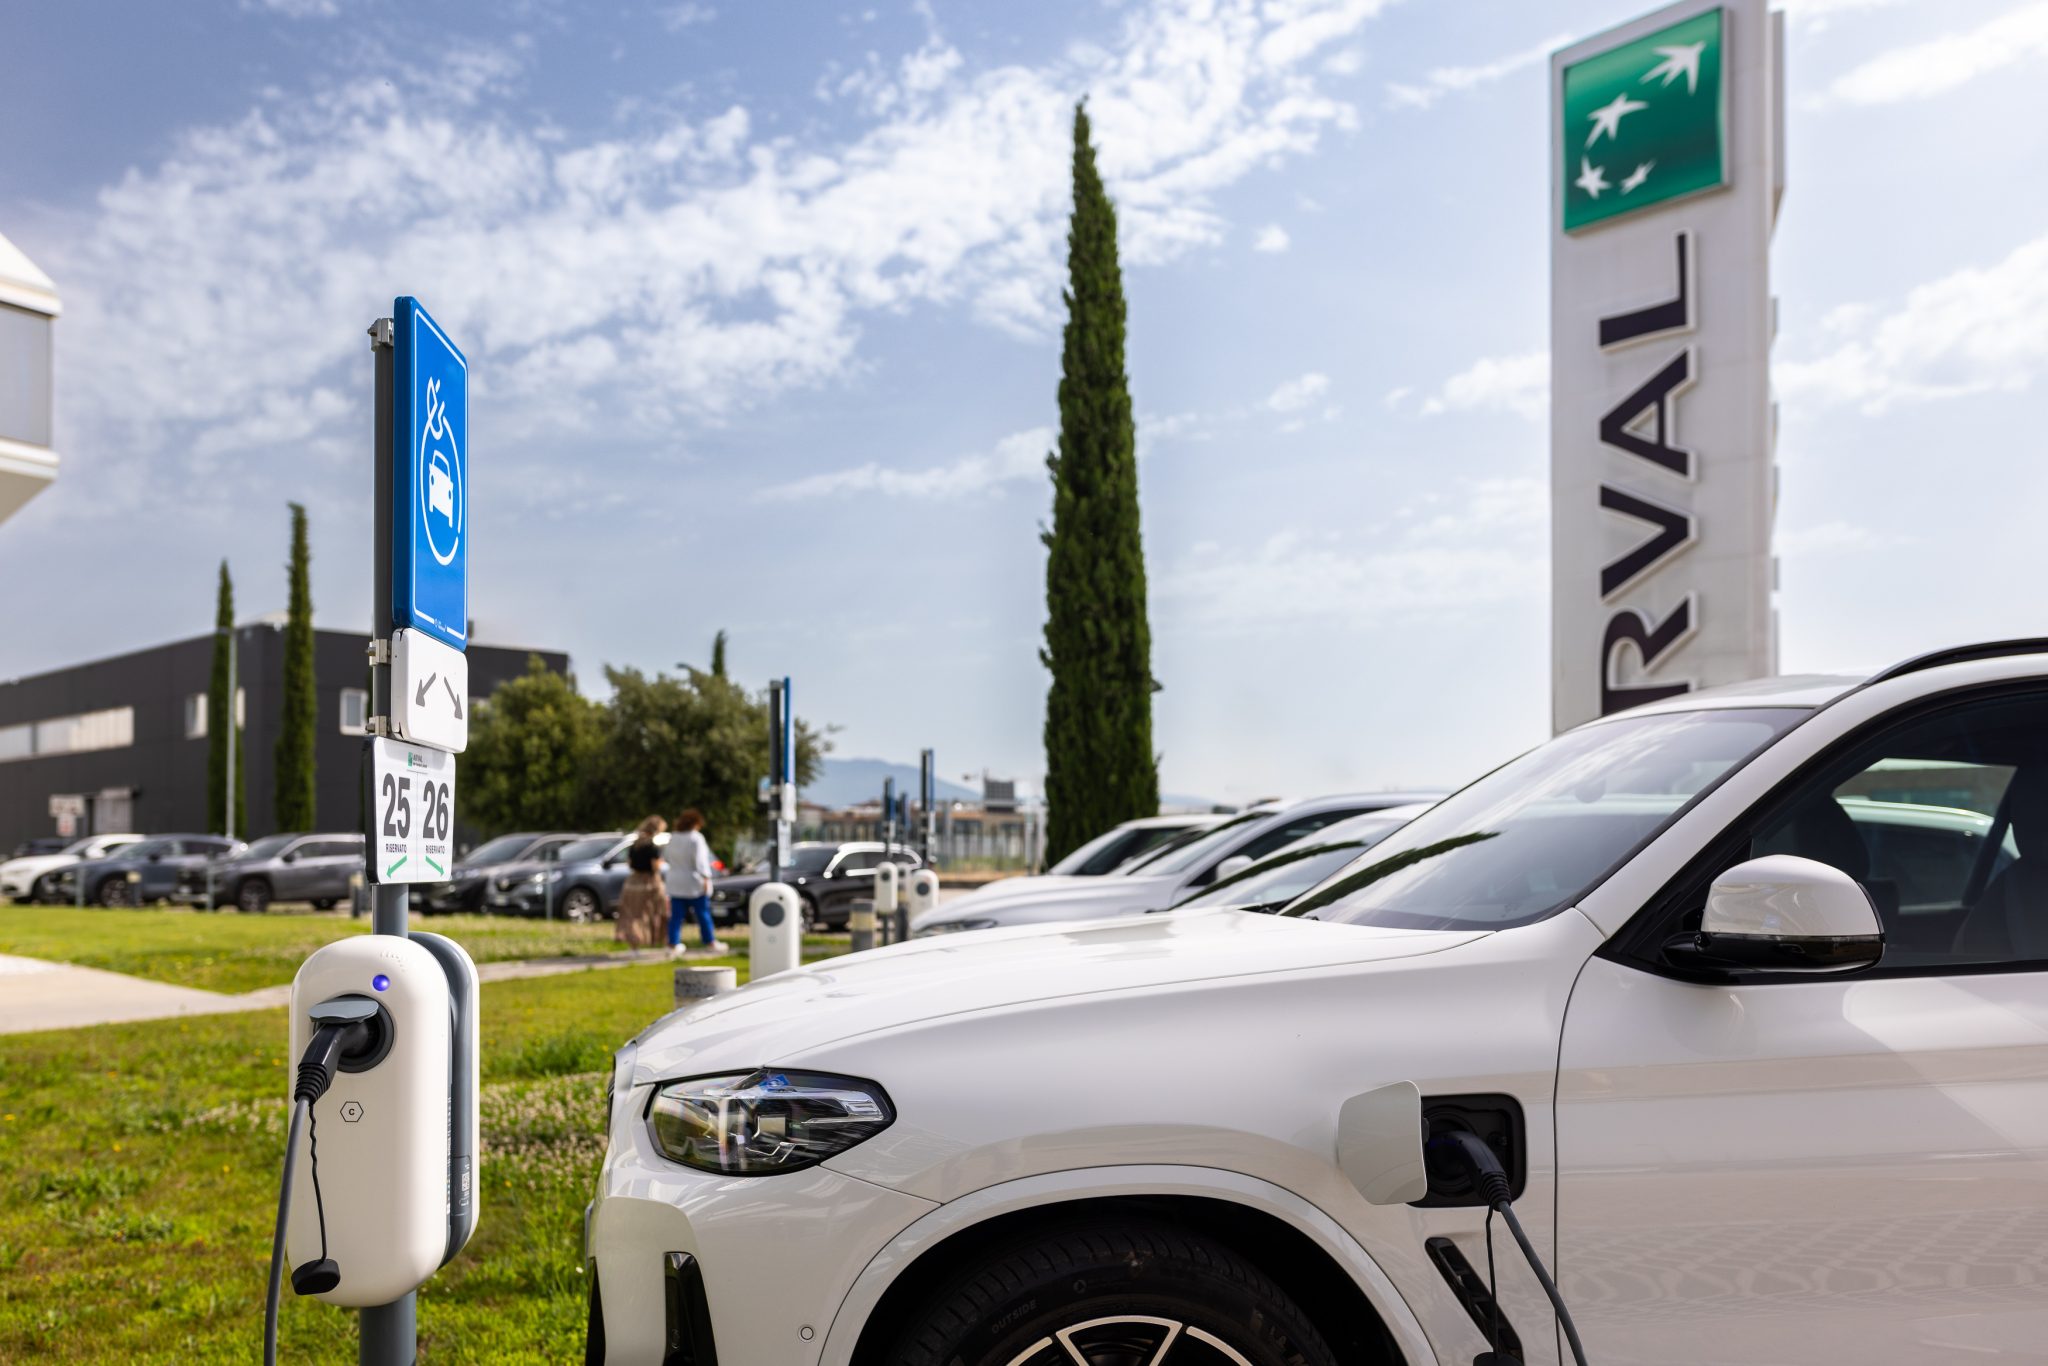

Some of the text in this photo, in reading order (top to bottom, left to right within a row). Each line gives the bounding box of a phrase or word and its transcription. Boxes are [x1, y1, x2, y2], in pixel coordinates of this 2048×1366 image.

[1599, 232, 1691, 716] RVAL
[382, 772, 411, 839] 25
[422, 779, 449, 841] 26
[385, 843, 407, 853] RISERVATO
[991, 1299, 1037, 1335] OUTSIDE
